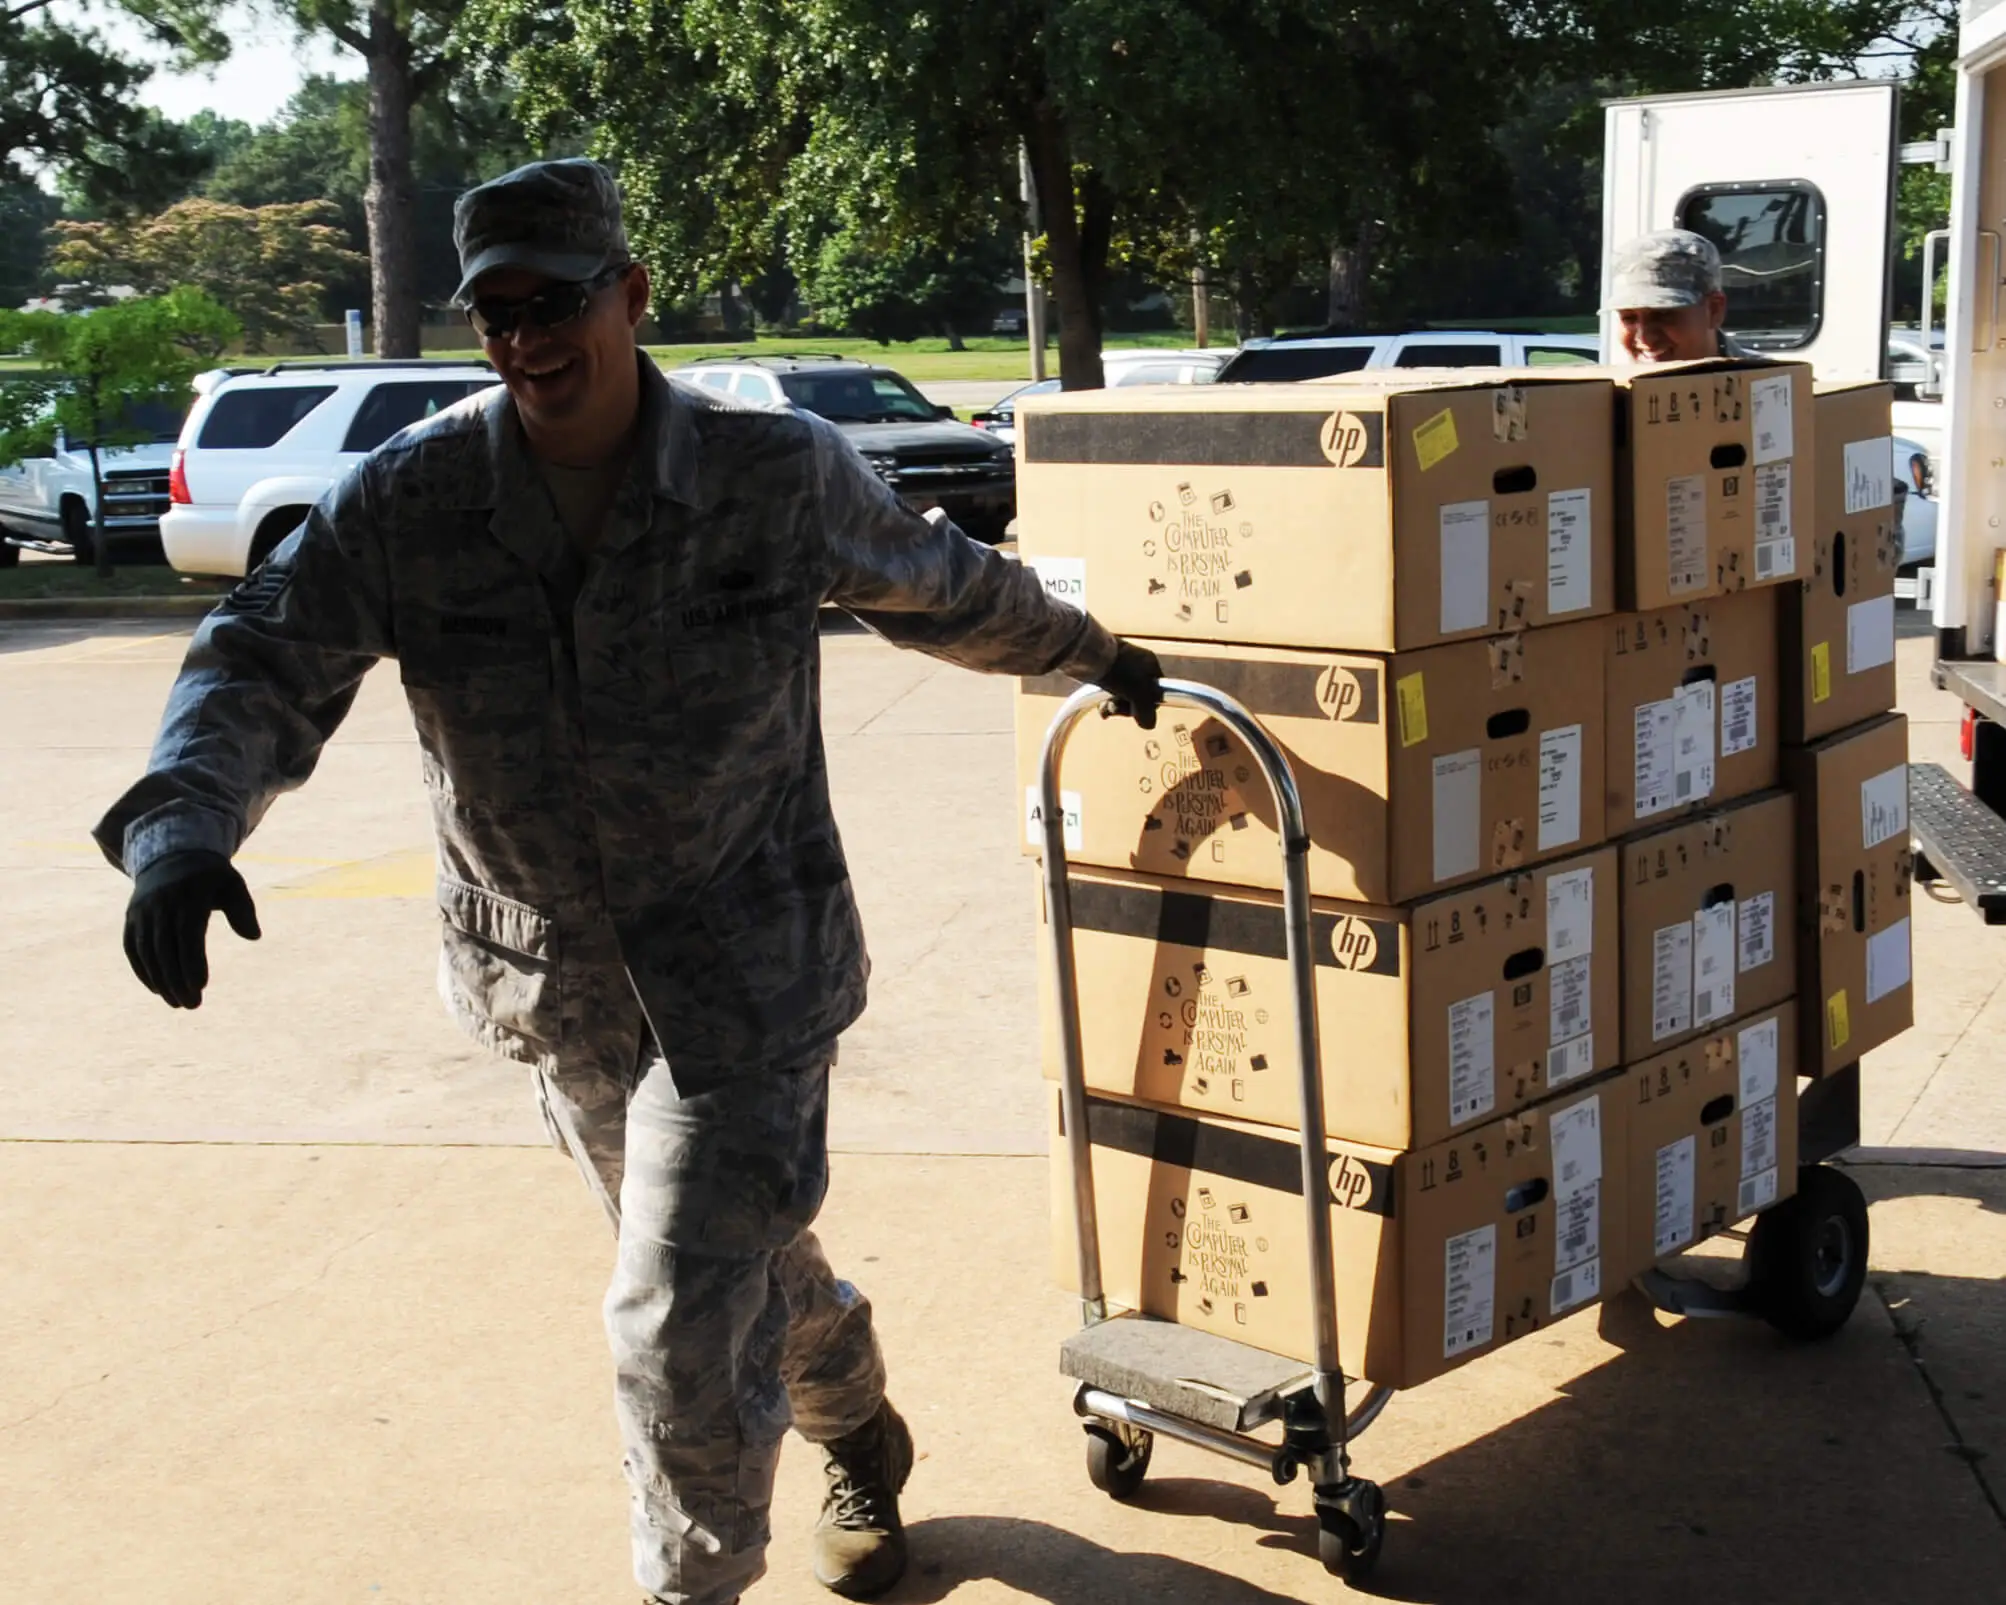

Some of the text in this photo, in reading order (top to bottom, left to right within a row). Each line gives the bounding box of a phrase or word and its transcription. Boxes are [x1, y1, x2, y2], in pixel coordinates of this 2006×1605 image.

[1328, 411, 1361, 468] hp
[1181, 511, 1204, 528] THE
[1164, 520, 1233, 553] COMPUTER
[1167, 554, 1178, 572] IS
[1045, 578, 1069, 594] MD
[1178, 575, 1220, 599] AGAIN
[1323, 665, 1355, 721] hp
[1178, 751, 1201, 769] THE
[1160, 761, 1229, 792] COMPUTER
[1163, 794, 1174, 809] IS
[1174, 814, 1216, 838] AGAIN
[1339, 916, 1370, 971] hp
[1198, 991, 1218, 1008] THE
[1181, 998, 1248, 1032] COMPUTER
[1183, 1029, 1194, 1046] IS
[1194, 1051, 1236, 1076] AGAIN
[1335, 1155, 1366, 1208] hp
[1200, 1213, 1221, 1232] THE
[1186, 1221, 1248, 1257] COMPUTER
[1188, 1251, 1199, 1266] IS
[1200, 1271, 1239, 1297] AGAIN
